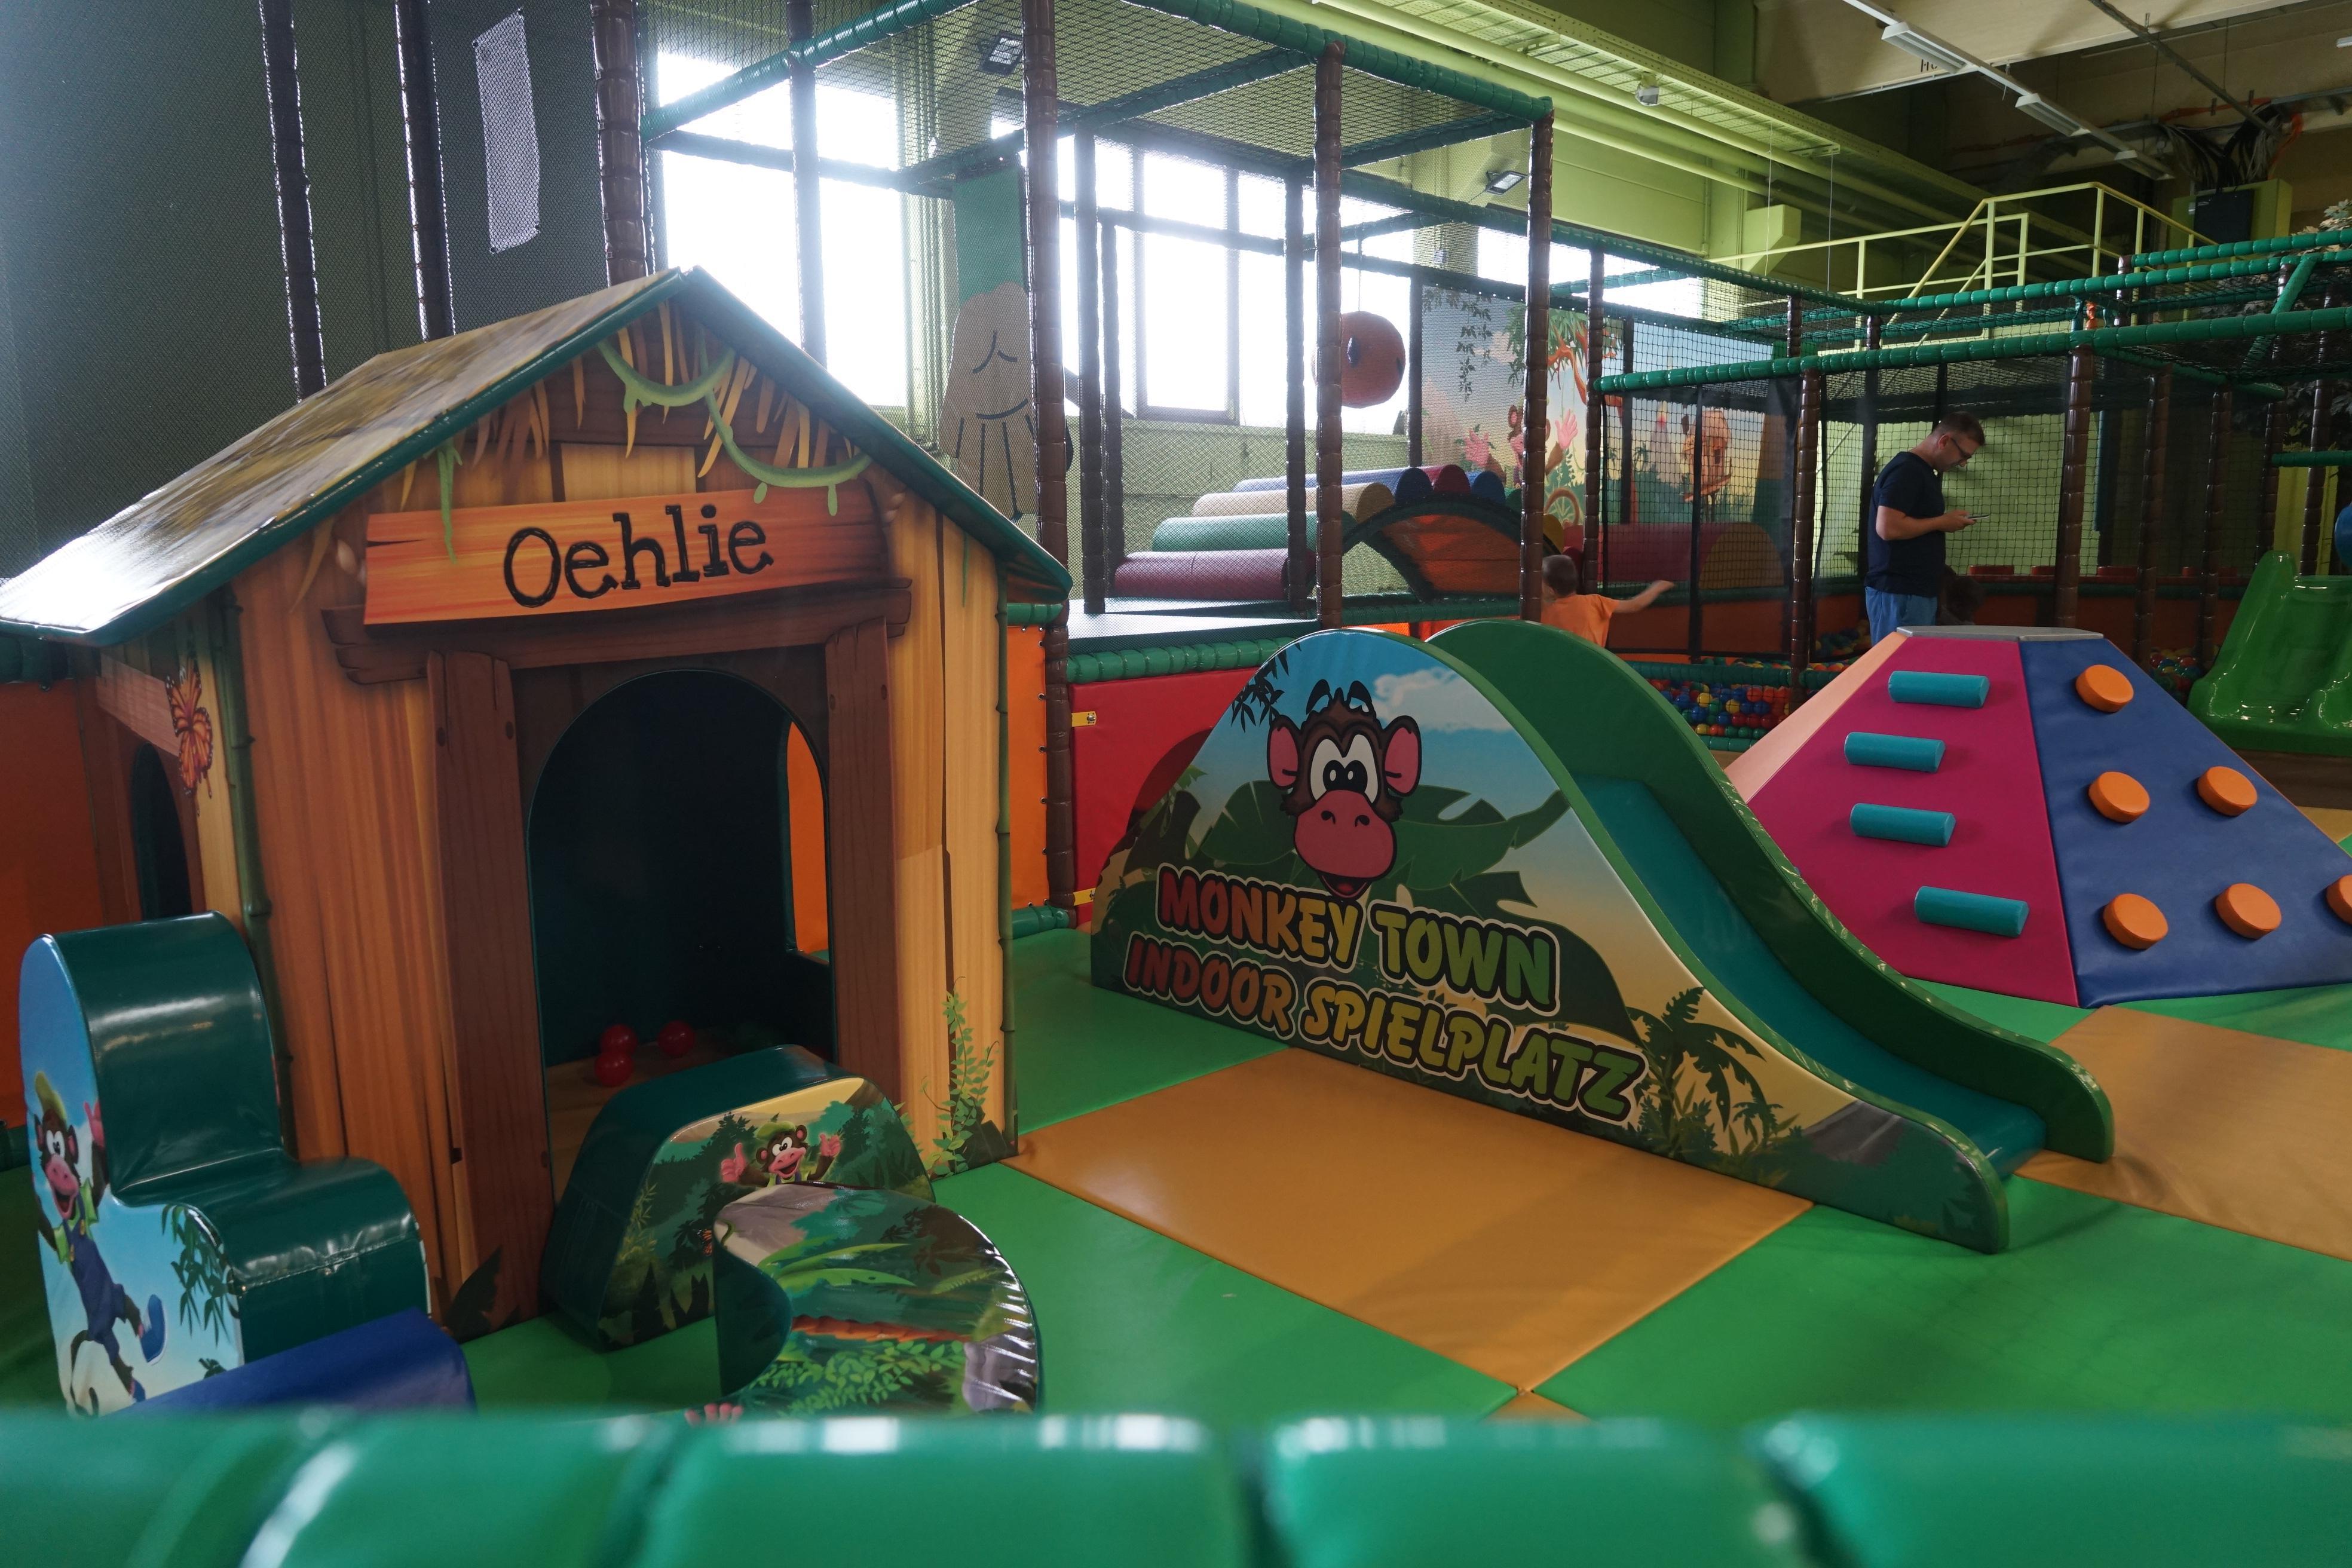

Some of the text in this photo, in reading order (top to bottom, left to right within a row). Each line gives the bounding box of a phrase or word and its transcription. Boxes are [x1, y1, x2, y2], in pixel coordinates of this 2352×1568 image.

[503, 504, 774, 608] Oehlie
[1157, 865, 1557, 1013] MONKEY TOWN
[1126, 935, 1645, 1121] INDOOR SPIELPLATZ
